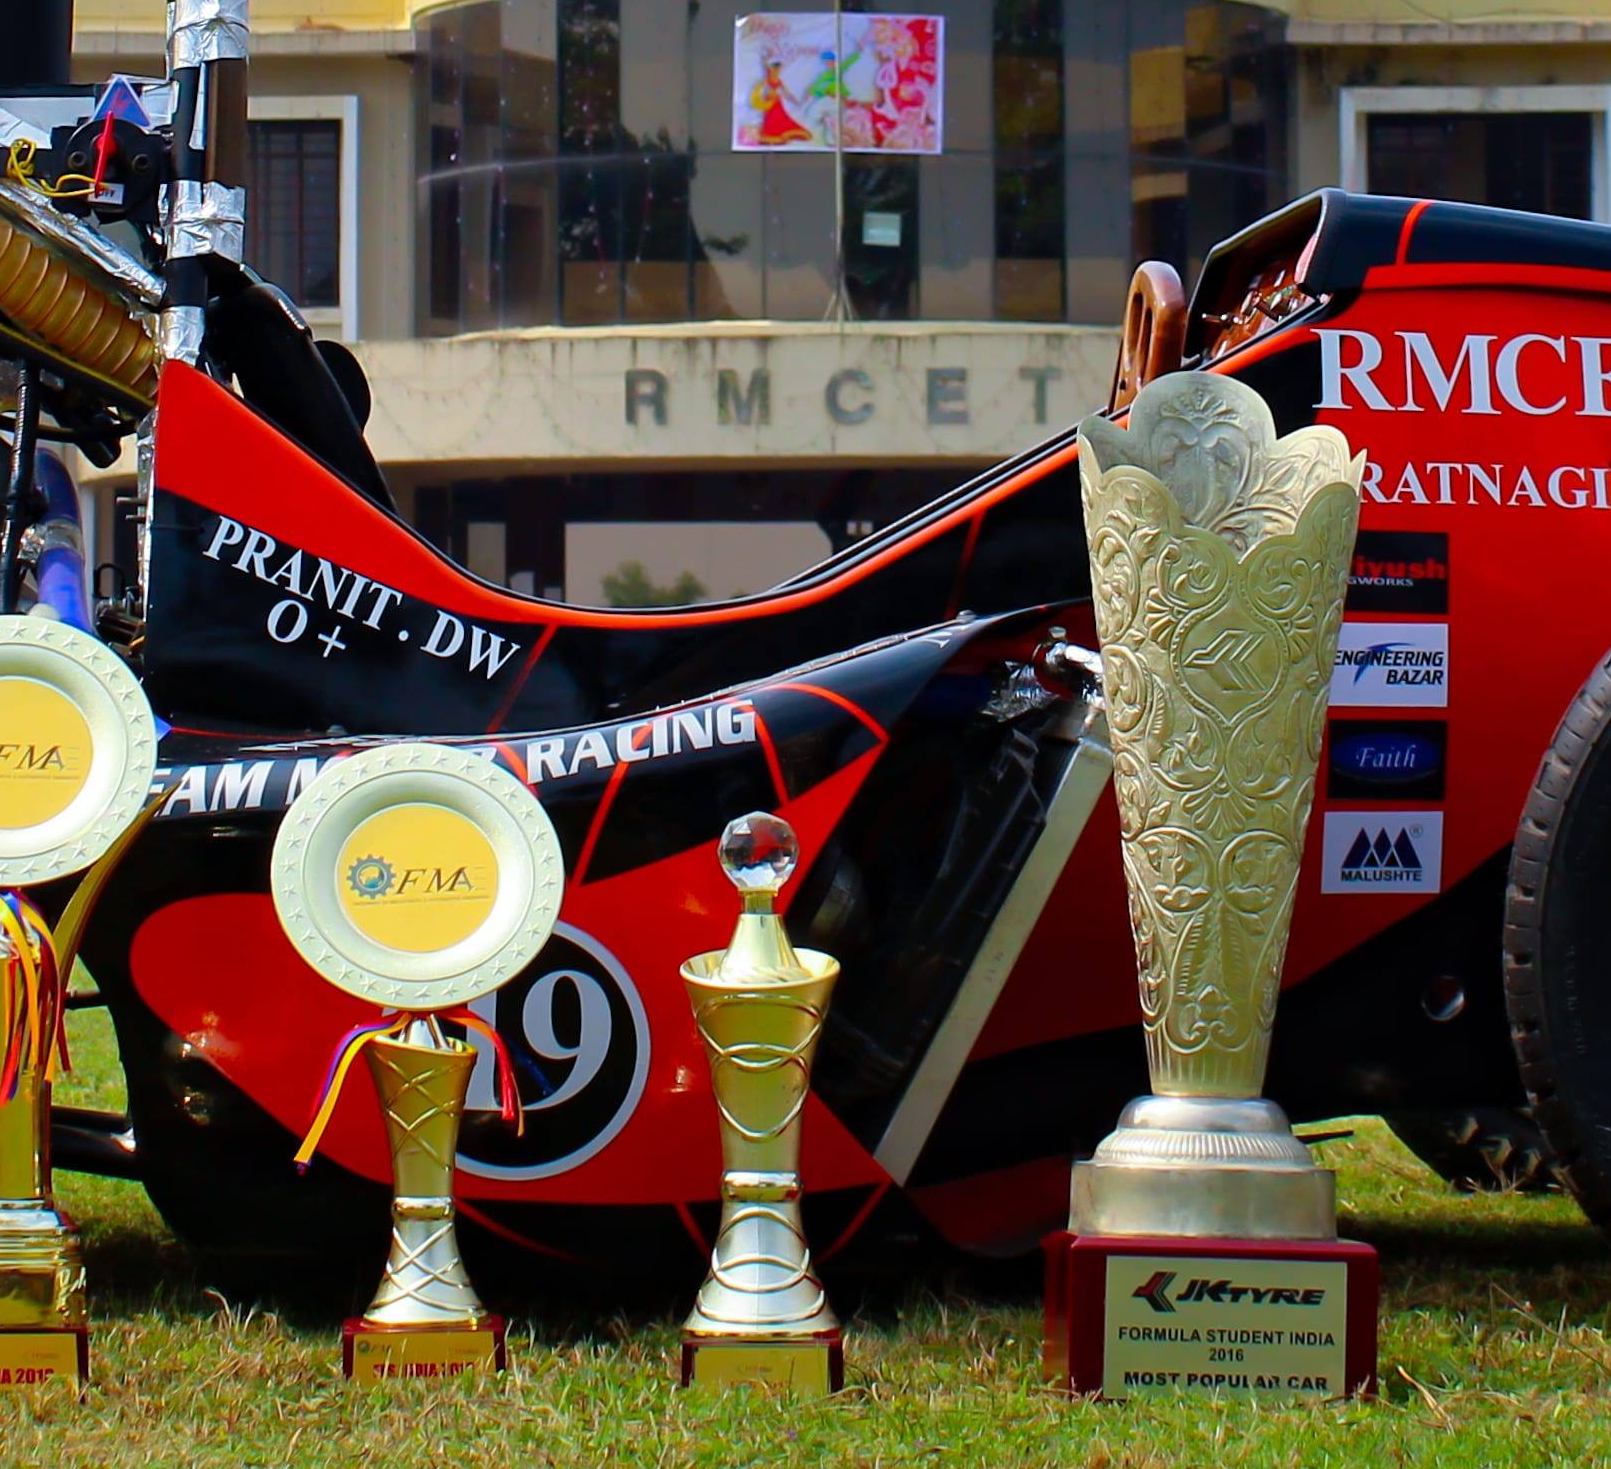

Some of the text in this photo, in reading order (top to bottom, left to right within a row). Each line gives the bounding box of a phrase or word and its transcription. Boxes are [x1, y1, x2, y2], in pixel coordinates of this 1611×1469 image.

[624, 367, 1061, 427] RMCET
[1353, 555, 1447, 581] iyush
[1346, 576, 1415, 588] GWORKS
[420, 609, 521, 681] DW
[1334, 649, 1445, 668] ENGINEERING
[1386, 669, 1444, 686] BAZAR
[526, 698, 757, 786] RACING
[1355, 743, 1418, 769] Faith
[1340, 868, 1424, 883] MALUSHTE
[1119, 1327, 1335, 1346] FORMULA STUDENT INDIA
[1209, 1348, 1244, 1362] 2016
[1123, 1371, 1328, 1391] MOST POPULAR CAR
